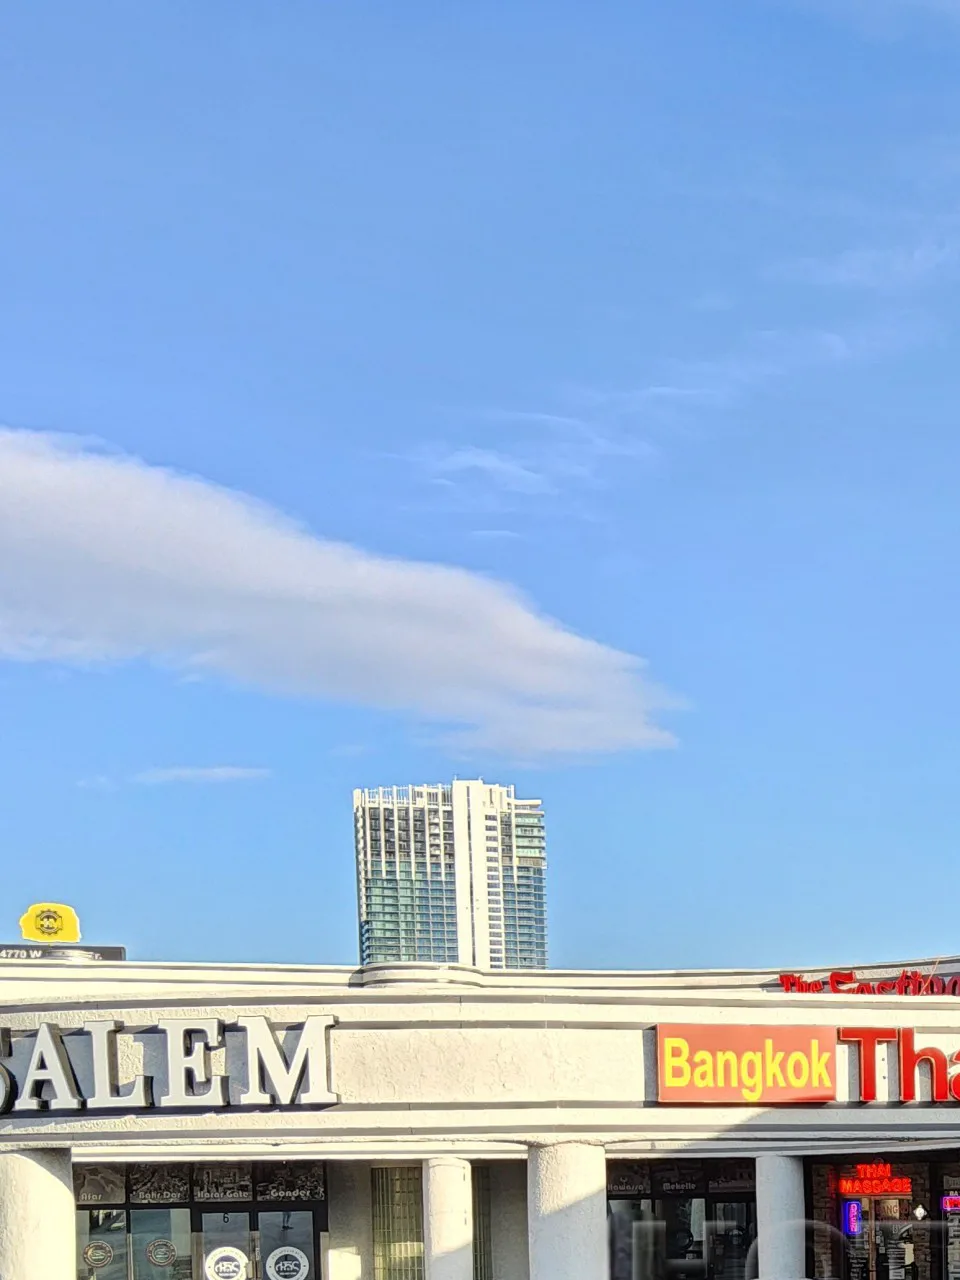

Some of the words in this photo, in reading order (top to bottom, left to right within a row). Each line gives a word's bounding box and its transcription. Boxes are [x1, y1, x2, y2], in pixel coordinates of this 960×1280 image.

[0, 1014, 340, 1114] ALEM
[664, 1037, 833, 1103] Bangkok
[856, 1163, 892, 1178] THAI
[271, 1188, 311, 1198] Gonder
[839, 1177, 912, 1194] MASSAGE
